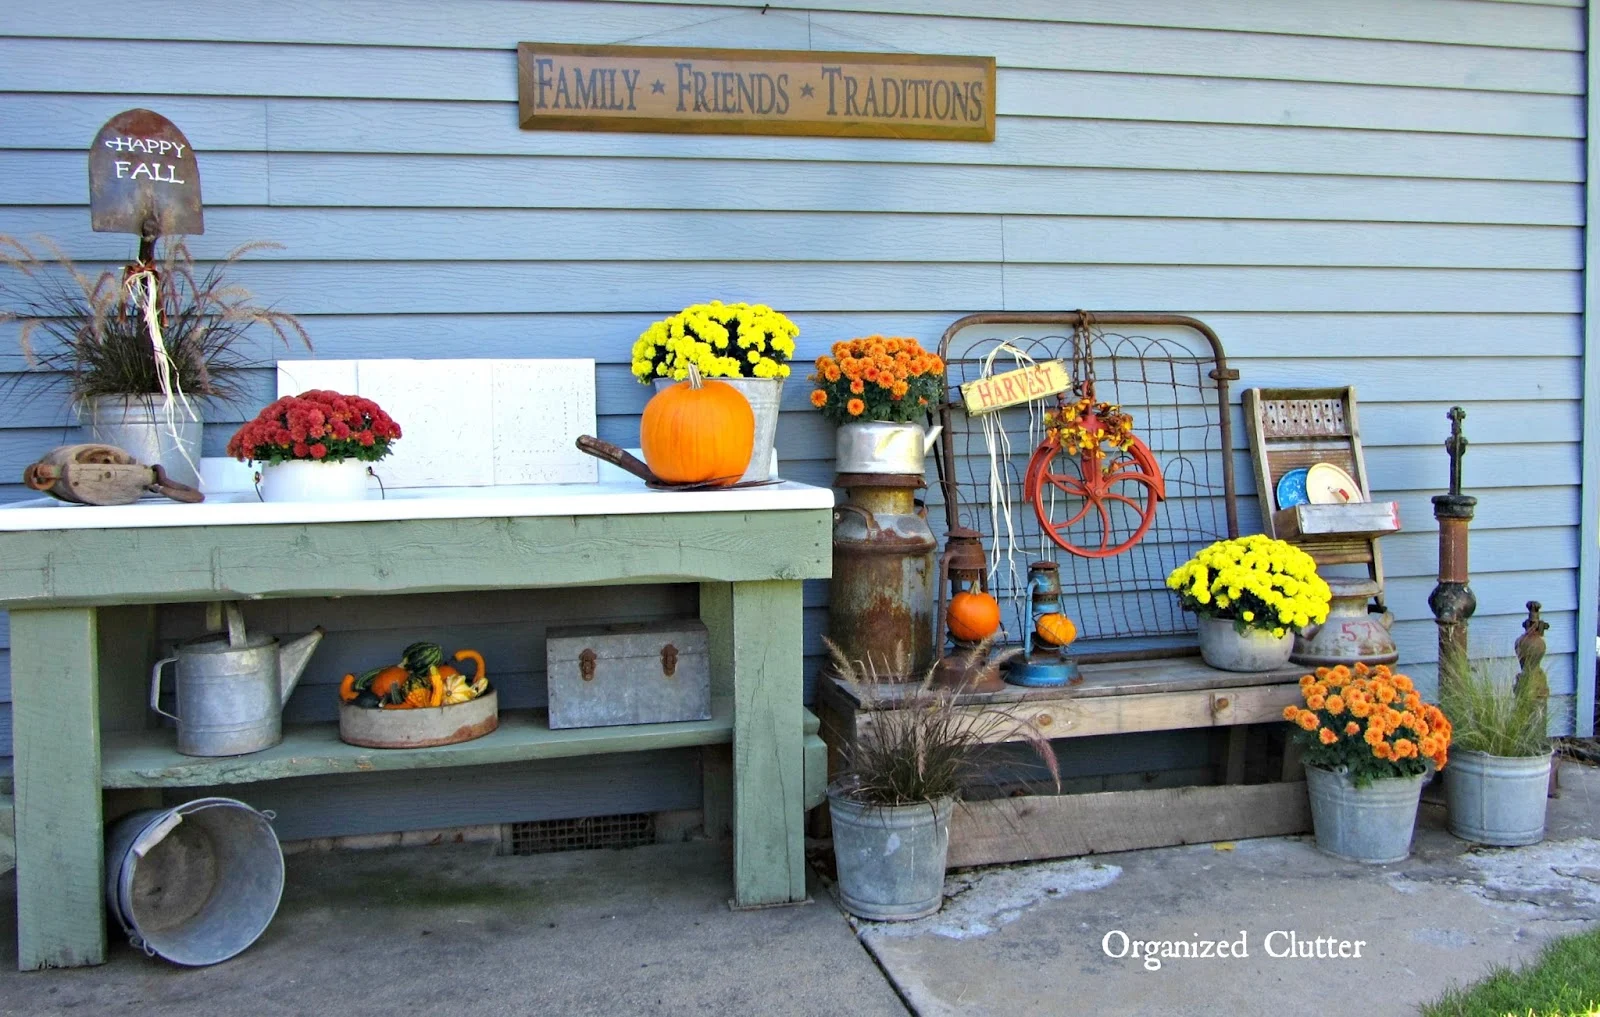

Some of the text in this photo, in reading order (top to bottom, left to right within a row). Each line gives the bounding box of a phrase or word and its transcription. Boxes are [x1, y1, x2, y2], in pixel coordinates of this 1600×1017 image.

[535, 58, 982, 123] FAMILY FRIENDS TRADITIONS
[105, 137, 185, 158] HAPPY
[115, 161, 185, 184] FALL
[977, 367, 1054, 407] HARVEST
